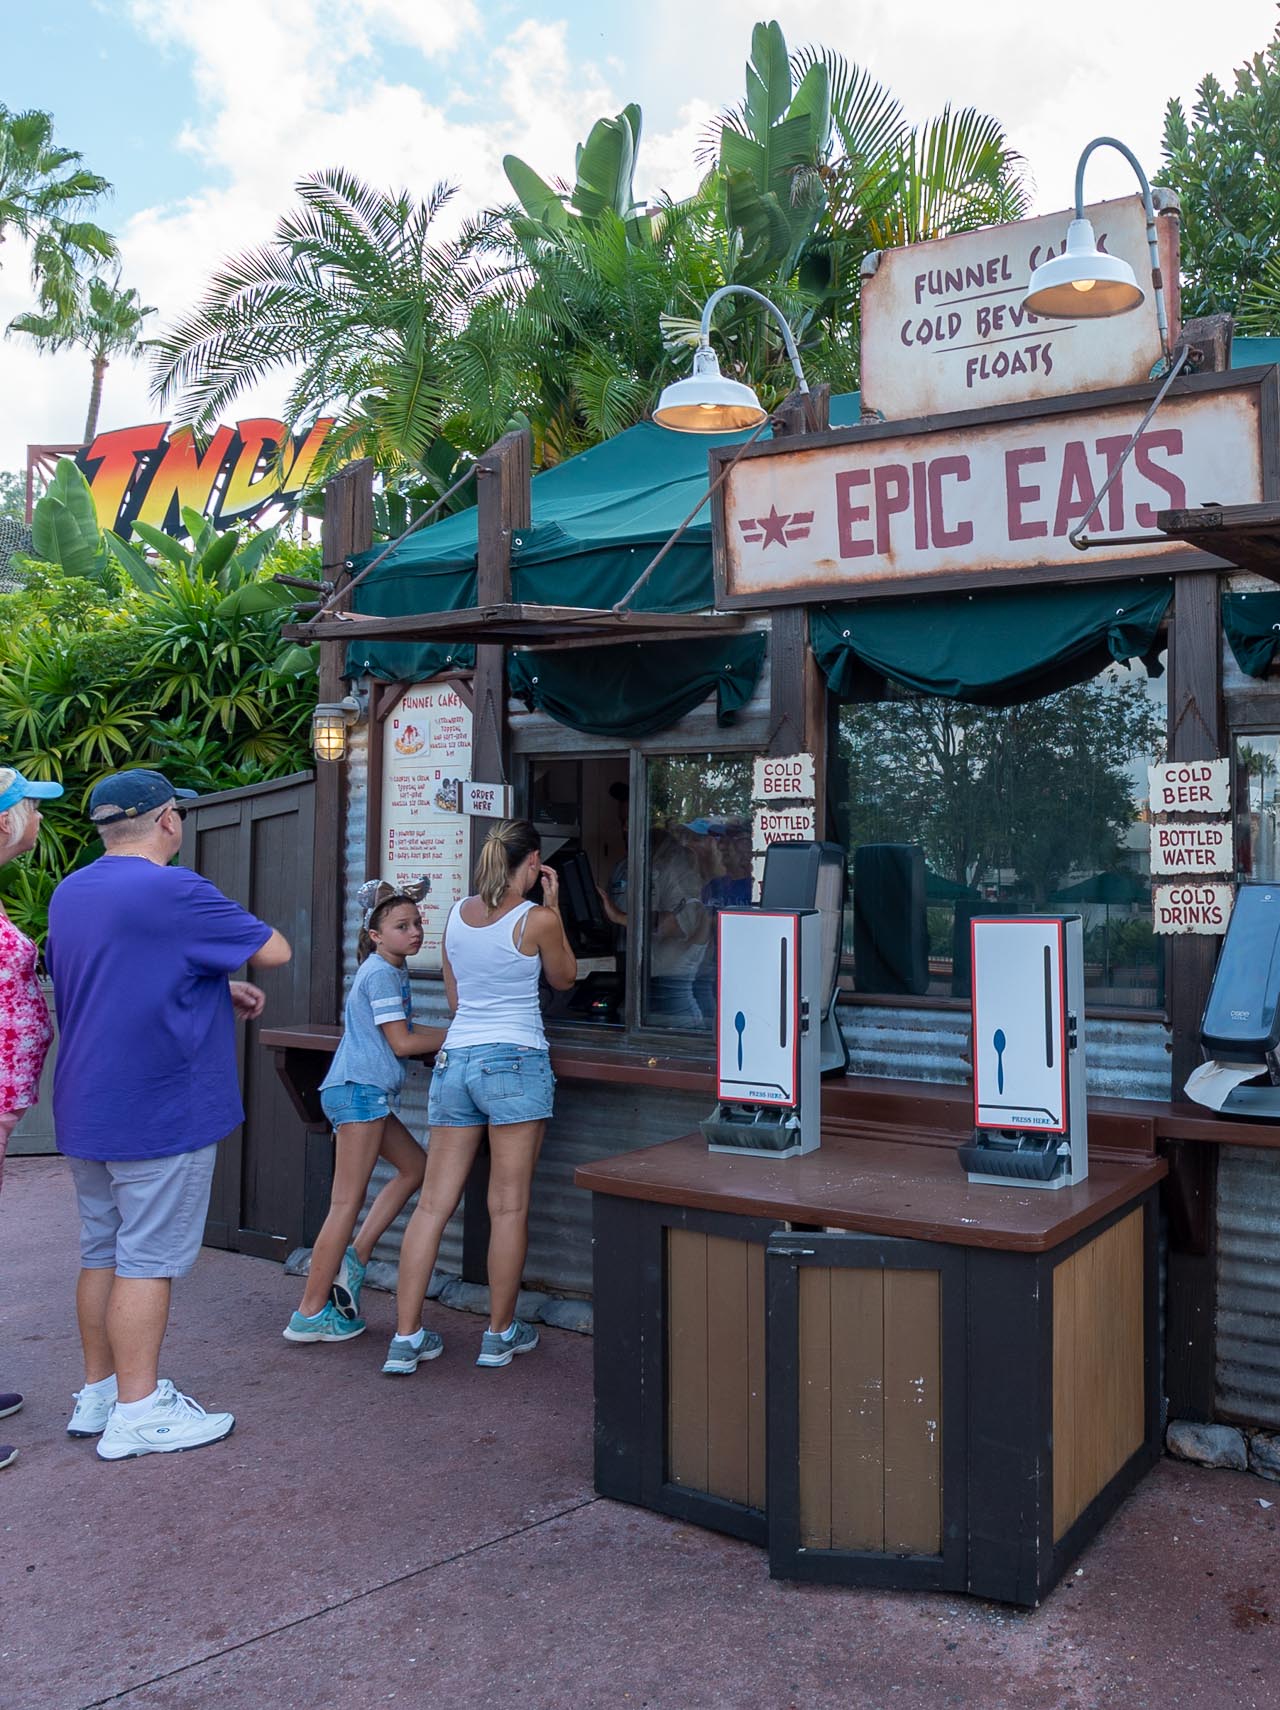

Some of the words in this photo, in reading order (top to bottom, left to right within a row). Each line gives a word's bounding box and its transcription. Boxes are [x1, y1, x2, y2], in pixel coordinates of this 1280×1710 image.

[914, 254, 1012, 304] FUNNEL
[1029, 233, 1109, 272] CAS
[900, 312, 962, 346] COLD
[966, 343, 1053, 388] FLOATS
[84, 417, 338, 540] INDI
[835, 454, 974, 559] EPIC
[1004, 429, 1186, 541] EATS
[764, 763, 802, 776] COLD
[1165, 767, 1212, 784] COLD
[763, 778, 802, 793] BEER
[470, 789, 495, 800] ORDER
[1162, 785, 1213, 804] BEER
[473, 801, 492, 811] HERE
[760, 815, 810, 830] BOTTLED
[1159, 830, 1223, 847] BOTTLED
[1163, 849, 1216, 865] WATER
[1169, 889, 1215, 905] COLD
[1160, 906, 1223, 925] DRINKS
[1032, 1117, 1050, 1125] HERE
